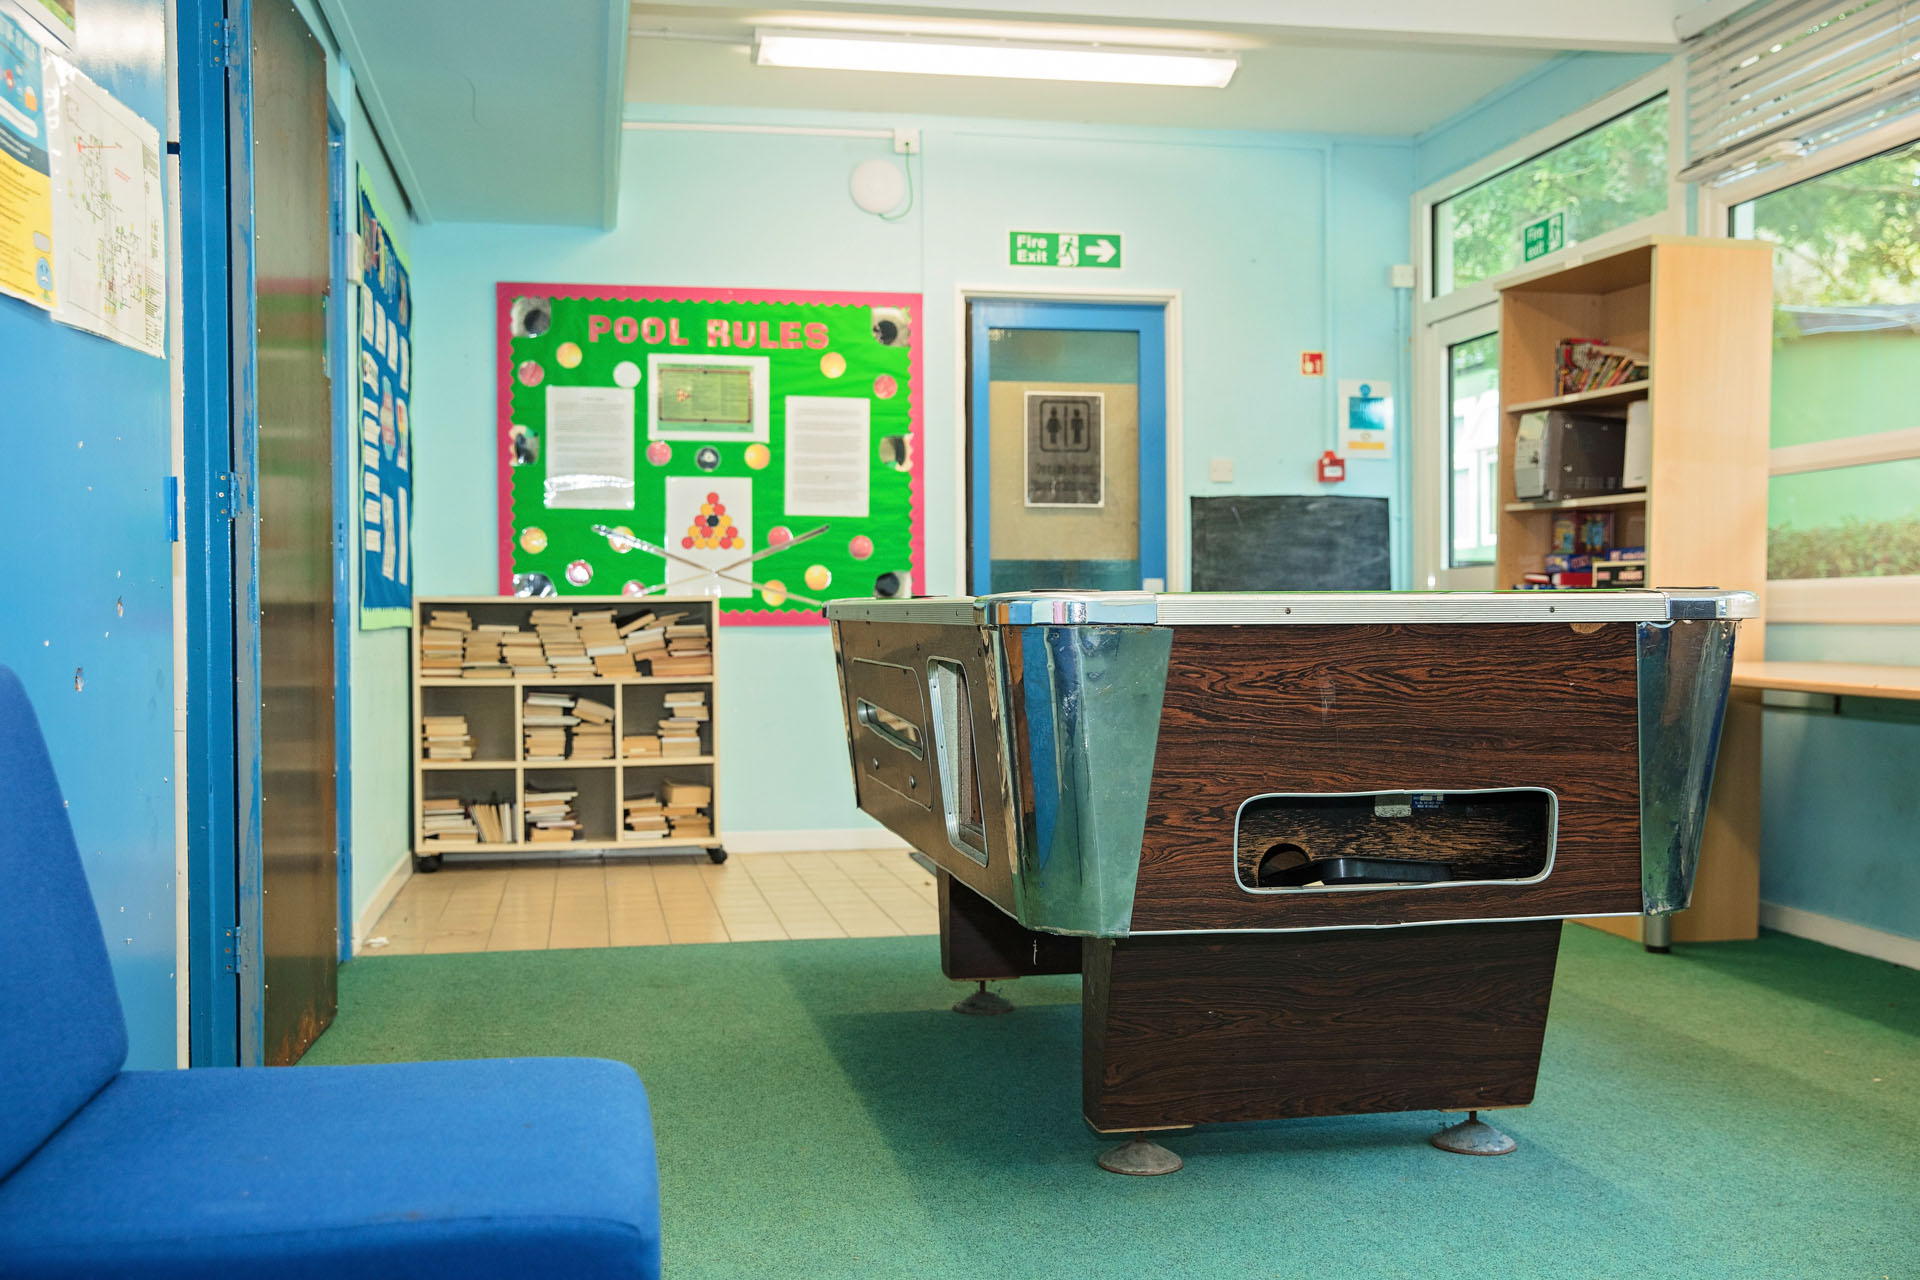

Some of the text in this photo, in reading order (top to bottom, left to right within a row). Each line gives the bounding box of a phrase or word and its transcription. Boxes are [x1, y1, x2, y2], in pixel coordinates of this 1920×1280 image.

[1016, 234, 1048, 249] Fire
[1016, 249, 1048, 263] Exit
[588, 315, 830, 350] POOL RULES
